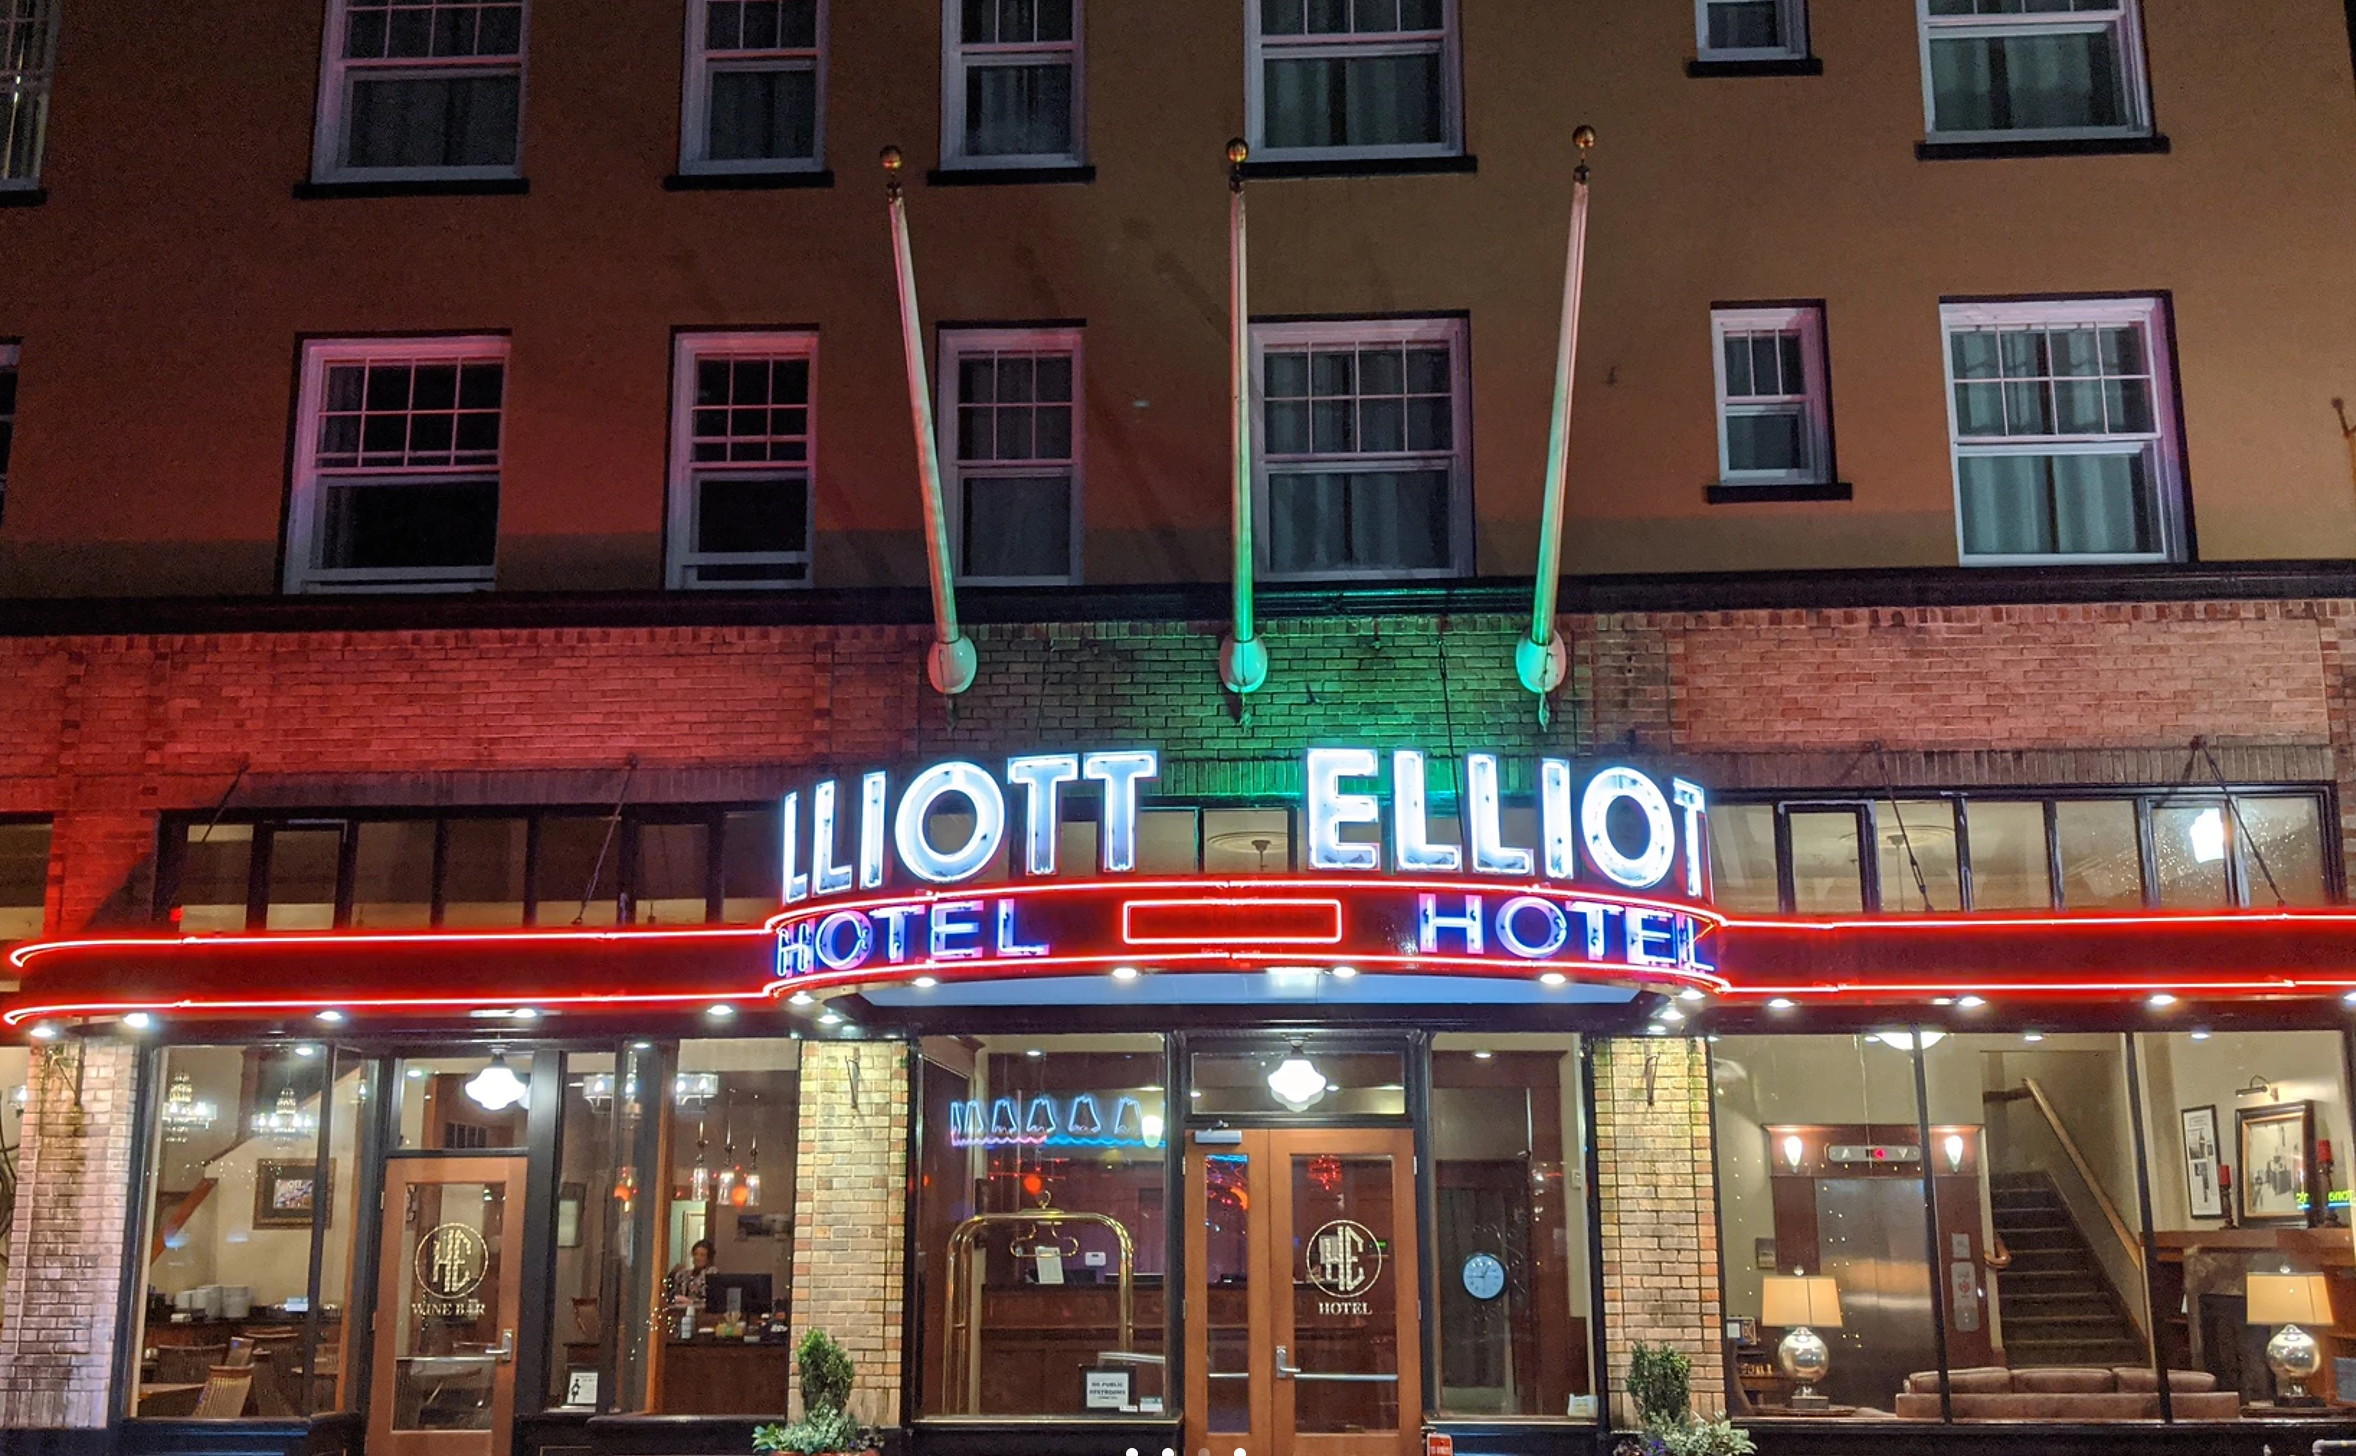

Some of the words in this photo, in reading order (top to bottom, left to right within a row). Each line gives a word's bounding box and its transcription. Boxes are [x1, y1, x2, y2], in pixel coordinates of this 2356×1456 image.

[776, 898, 1050, 978] HOTEL
[1418, 892, 1715, 974] HOTEL
[411, 1303, 453, 1315] WINE
[1318, 1302, 1373, 1315] HOTEL
